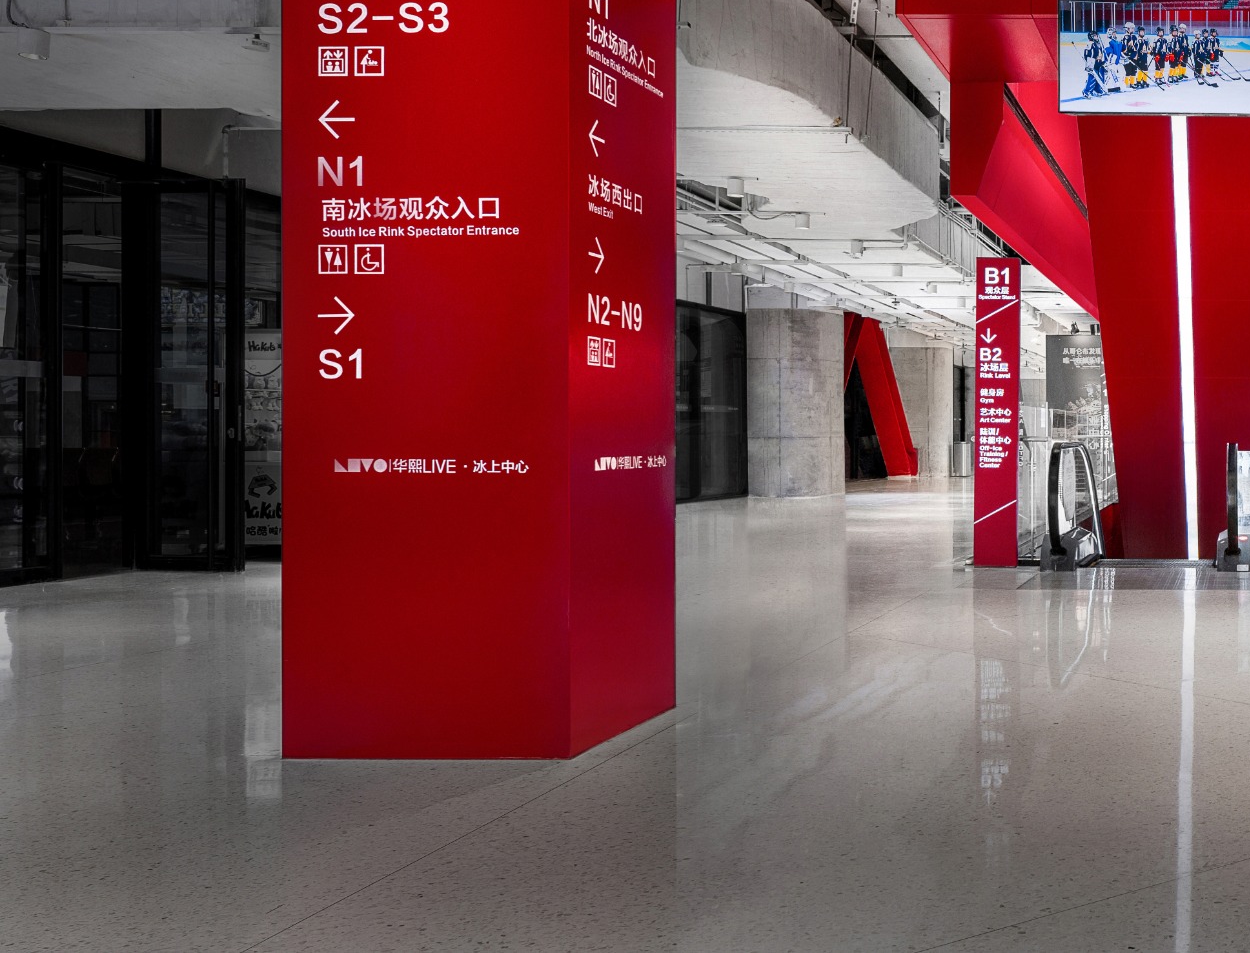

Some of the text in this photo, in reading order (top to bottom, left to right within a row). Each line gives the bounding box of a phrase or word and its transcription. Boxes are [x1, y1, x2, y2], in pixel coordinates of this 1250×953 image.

[317, 1, 450, 35] S2-S3
[586, 17, 656, 79] 北冰场观众入口
[586, 44, 602, 62] North
[317, 155, 363, 187] N1
[587, 173, 643, 215] 冰场西出口
[321, 195, 500, 222] 南冰场观众入口
[588, 201, 603, 216] West
[322, 225, 520, 239] South Ice Rink Spectator Entrance
[984, 267, 1010, 285] B1
[587, 293, 643, 332] N2-N9
[318, 348, 363, 380] S1
[979, 347, 1002, 361] B2
[979, 397, 995, 405] Gym
[979, 407, 1012, 417] 艺术中心
